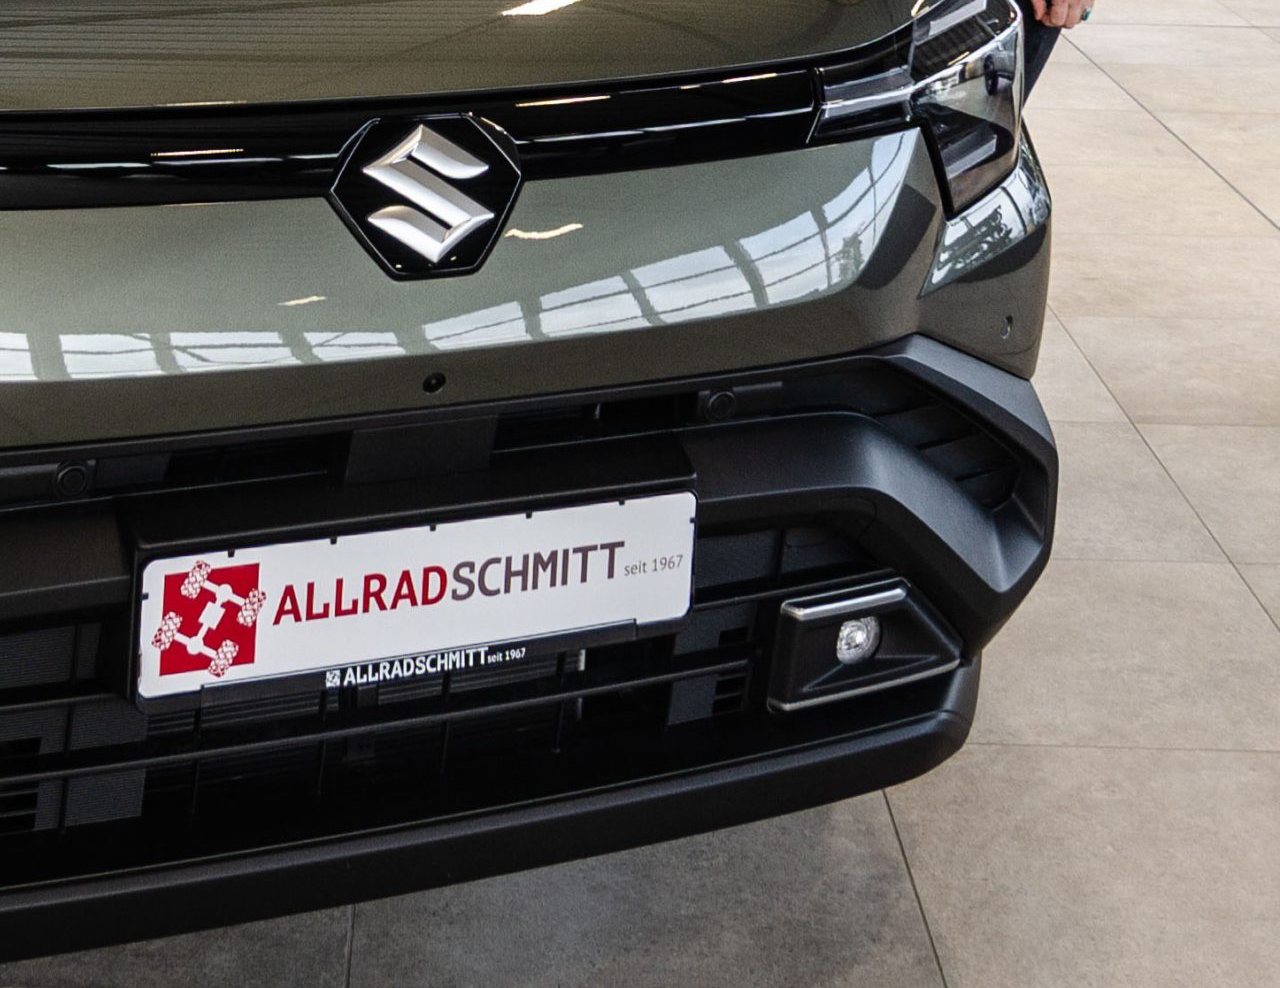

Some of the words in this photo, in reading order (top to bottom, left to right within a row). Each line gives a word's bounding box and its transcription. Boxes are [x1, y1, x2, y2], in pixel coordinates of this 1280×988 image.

[273, 541, 625, 625] ALLRADSCHMITT
[624, 559, 648, 576] seit
[652, 555, 683, 572] 1967
[343, 646, 488, 686] ALLRADSCHMITT
[488, 653, 503, 663] seit
[505, 648, 526, 660] 1967
